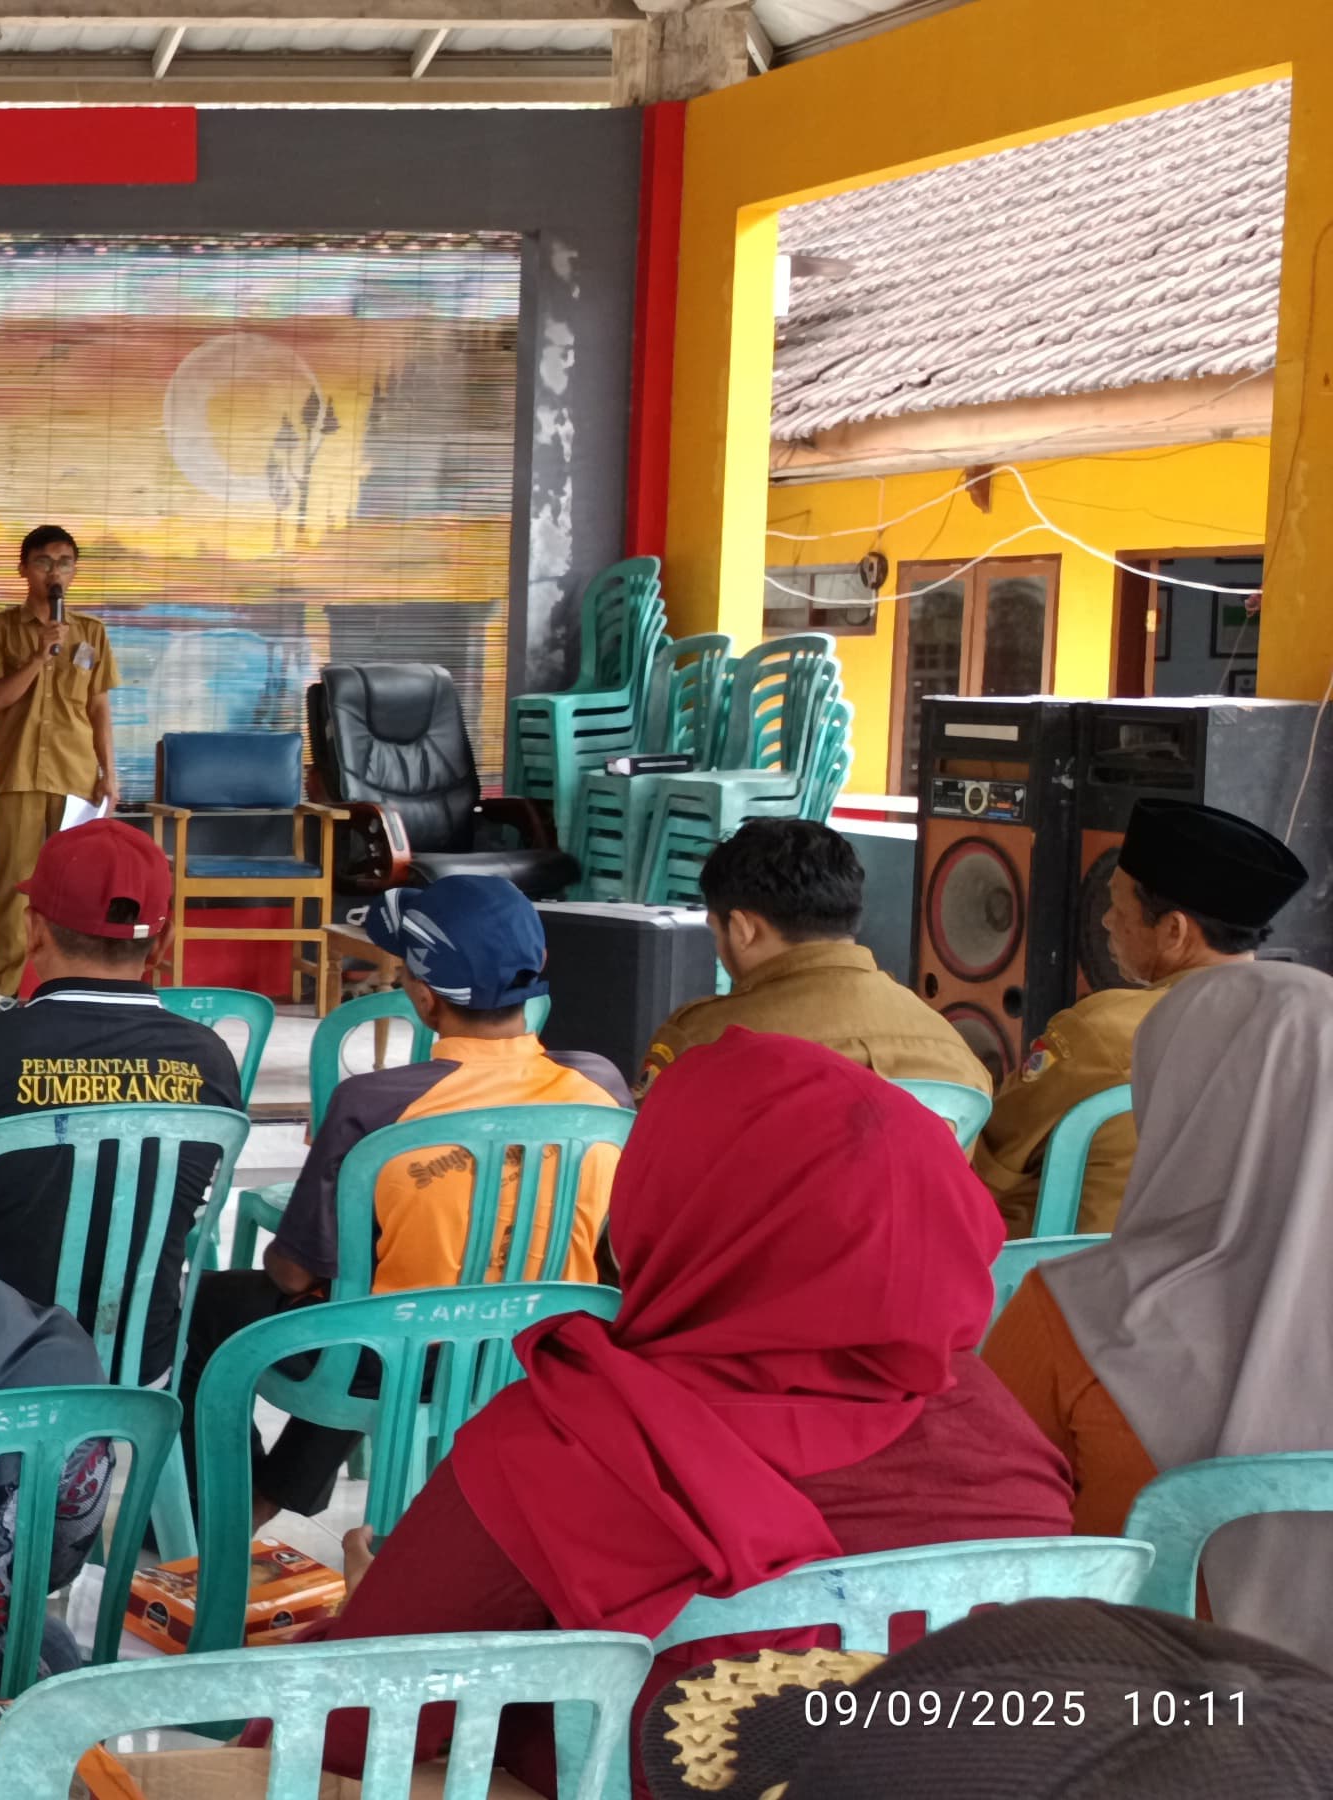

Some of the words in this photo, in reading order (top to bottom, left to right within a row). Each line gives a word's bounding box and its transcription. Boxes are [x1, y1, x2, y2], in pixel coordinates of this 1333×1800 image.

[20, 1058, 148, 1075] PEMERINTAH
[157, 1058, 201, 1078] DESA
[16, 1074, 204, 1105] SUMBERANGET
